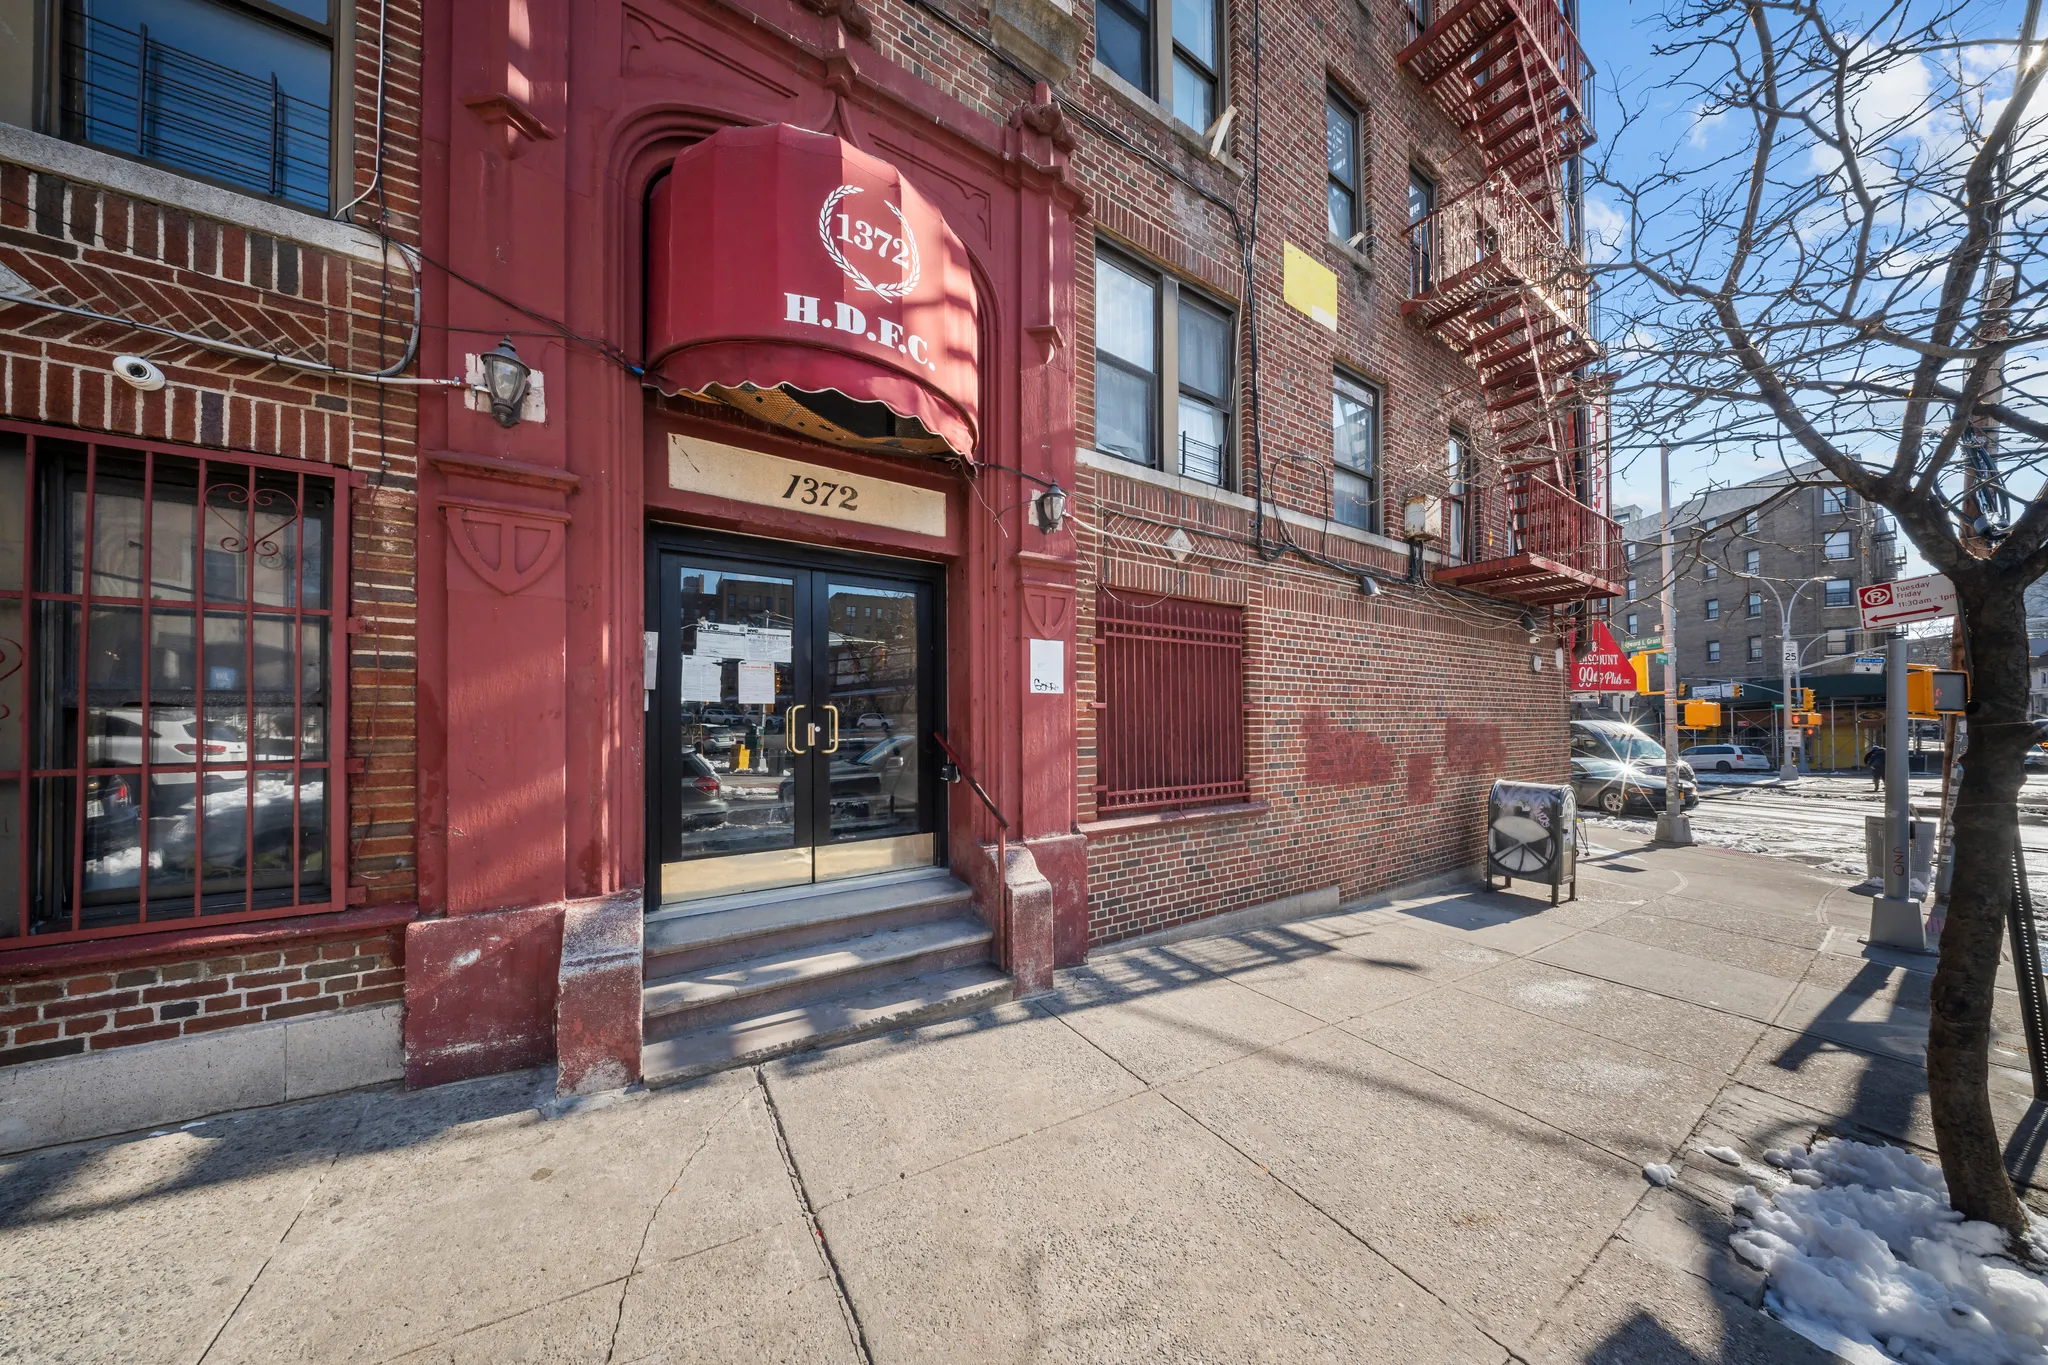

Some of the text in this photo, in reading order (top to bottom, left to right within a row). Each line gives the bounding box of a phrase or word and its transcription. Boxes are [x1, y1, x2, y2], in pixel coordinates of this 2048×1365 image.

[836, 213, 910, 271] 1372
[783, 292, 936, 371] H.D.F.C.
[781, 473, 859, 511] 1372
[1896, 581, 1931, 592] Tuesday
[1896, 590, 1922, 600] Friday
[1898, 597, 1932, 607] 11:30am
[1940, 593, 1957, 601] 1pm
[1646, 637, 1661, 645] Grant
[1785, 652, 1797, 661] 25
[1604, 671, 1622, 684] Plus
